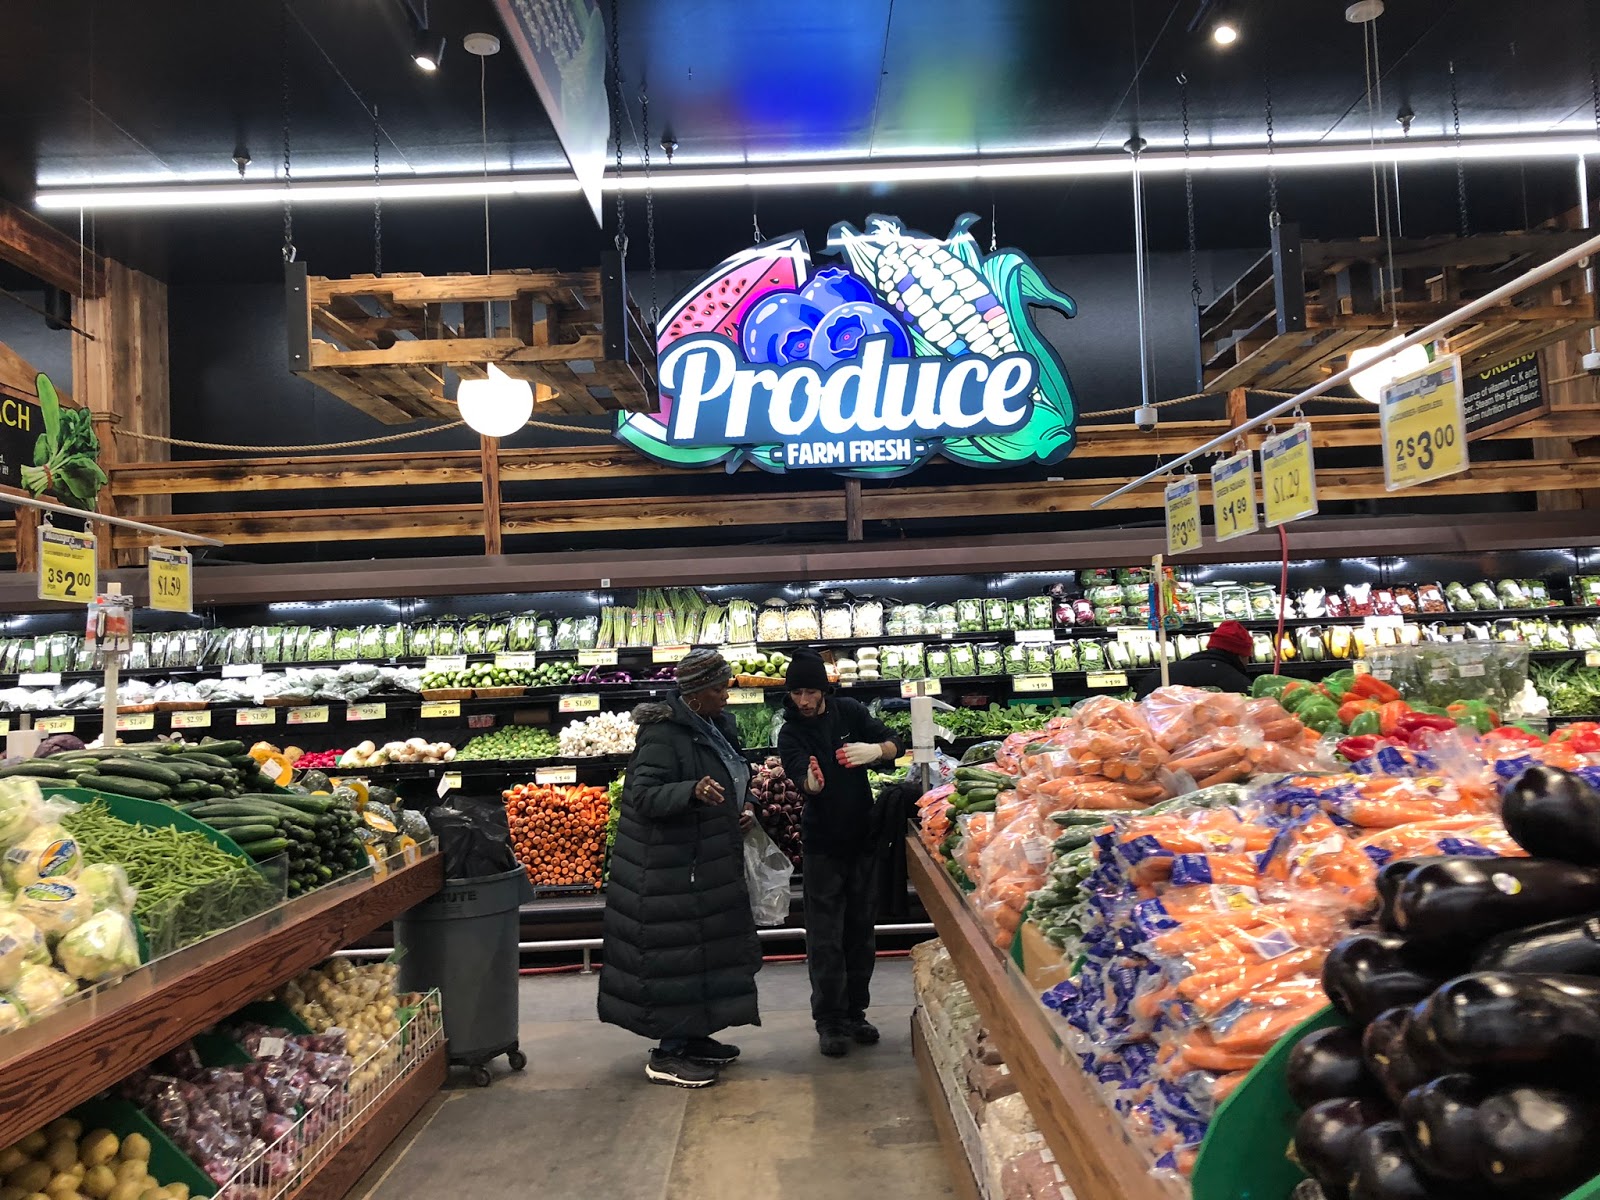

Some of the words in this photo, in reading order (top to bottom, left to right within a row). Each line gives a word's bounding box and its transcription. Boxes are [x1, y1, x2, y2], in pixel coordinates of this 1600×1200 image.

[660, 339, 1032, 440] Produce
[1464, 392, 1480, 404] ource
[1481, 387, 1488, 397] of
[1488, 379, 1511, 394] vitamin
[1519, 371, 1525, 382] K
[1525, 366, 1538, 379] and
[1475, 397, 1495, 410] Steam
[1495, 392, 1506, 402] the
[1506, 383, 1529, 400] greens
[1529, 378, 1539, 389] for
[1481, 403, 1507, 419] nutrition
[1507, 397, 1519, 409] and
[1519, 390, 1540, 404] flavor.
[787, 442, 844, 465] FARM
[850, 438, 911, 464] FRESH
[157, 575, 181, 597] $1.59
[575, 699, 592, 707] $1.99
